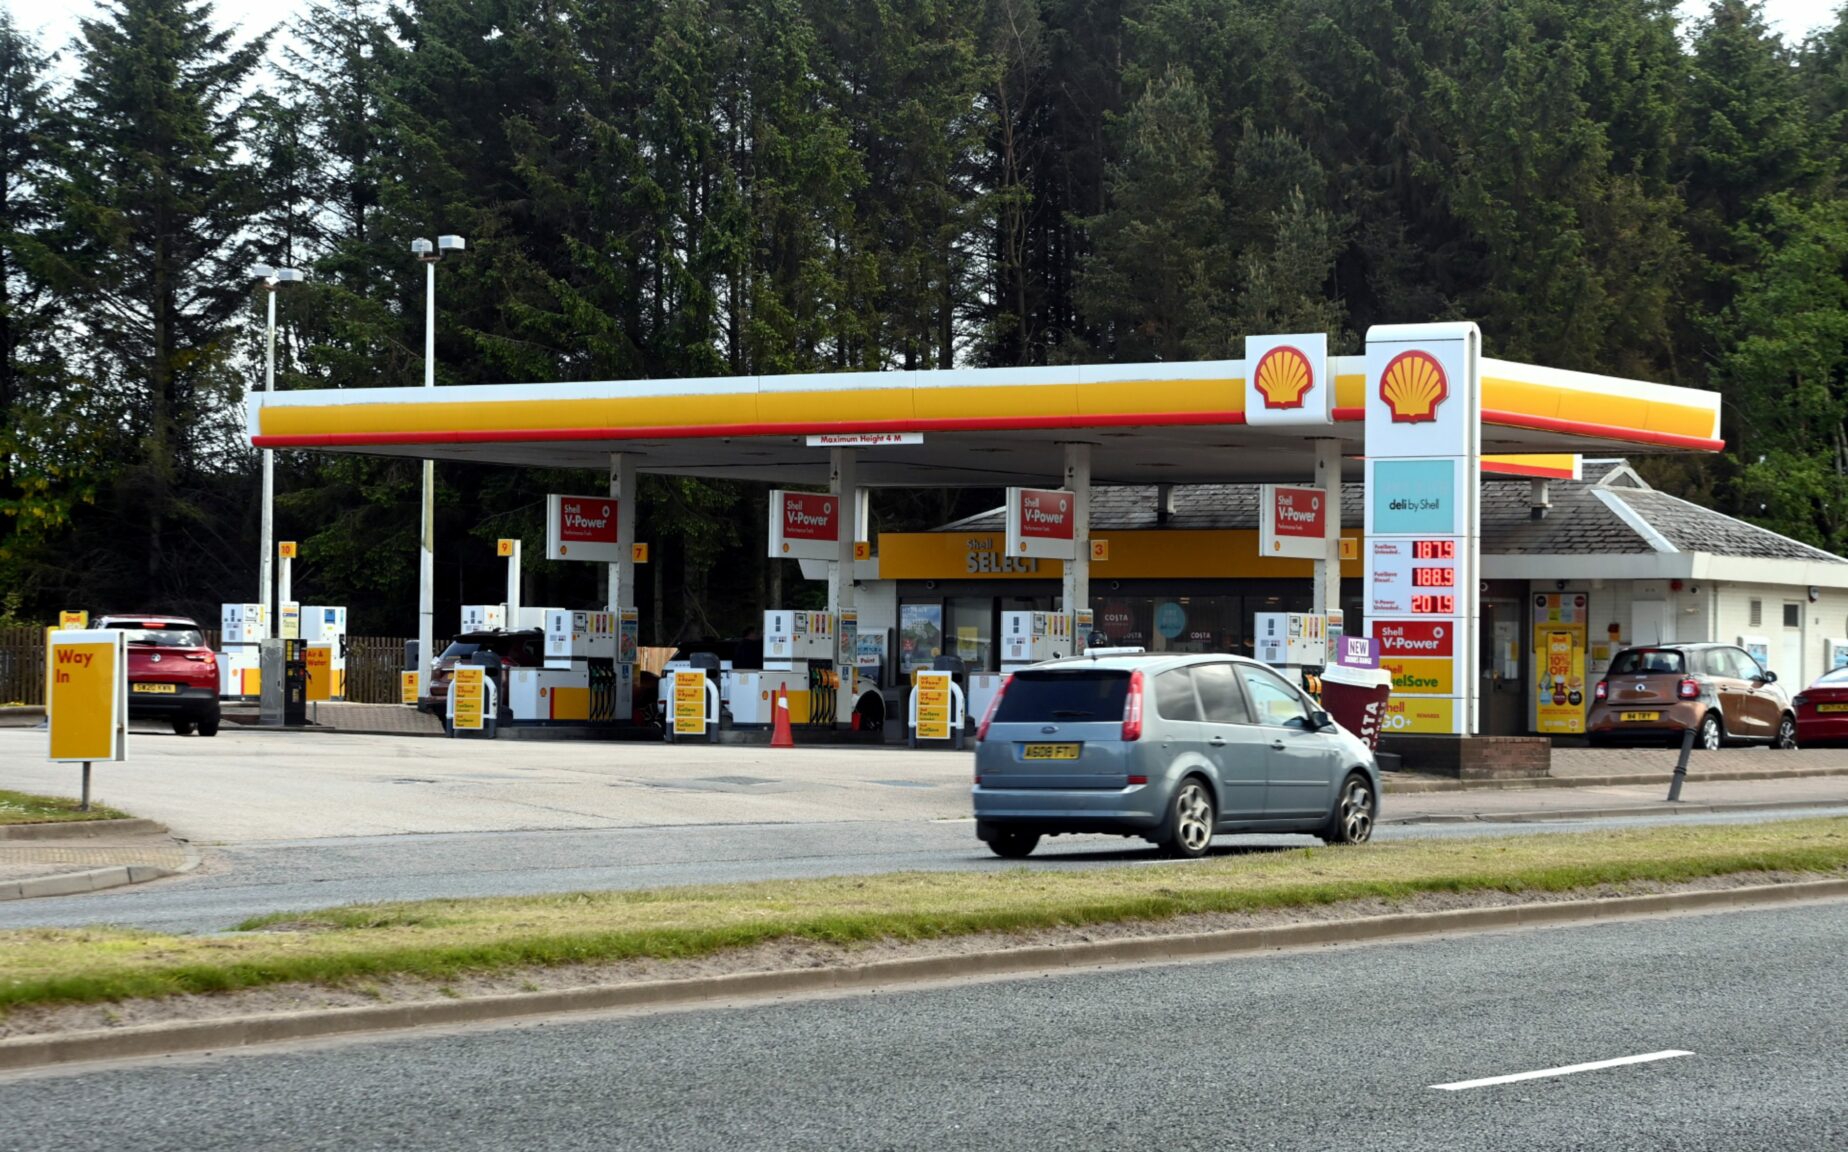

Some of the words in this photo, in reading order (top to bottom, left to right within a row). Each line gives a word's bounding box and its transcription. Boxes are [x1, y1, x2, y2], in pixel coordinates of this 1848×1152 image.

[821, 435, 858, 444] Maximum
[860, 434, 884, 444] Height
[886, 434, 892, 442] 4
[894, 434, 902, 442] M
[786, 500, 803, 510] Shell
[1024, 498, 1040, 508] Shell
[1278, 495, 1293, 506] Shell
[1389, 498, 1407, 510] deli
[1408, 499, 1419, 512] by
[1420, 498, 1440, 510] Shell
[564, 504, 581, 514] Shell
[1278, 506, 1316, 523] V-Power
[564, 515, 607, 528] V-Power
[787, 511, 828, 526] V-Power
[1024, 509, 1064, 524] V-Power
[967, 537, 993, 550] Shell
[1095, 544, 1104, 555] 3
[1416, 541, 1455, 558] 187.9
[636, 547, 643, 558] 7
[857, 546, 864, 556] 5
[966, 552, 1038, 574] SELECT
[1416, 568, 1454, 586] 188.9
[1411, 595, 1454, 613] 201.9
[1104, 614, 1128, 622] COSTA
[1382, 627, 1403, 636] Shell
[1350, 640, 1367, 655] NEW
[1382, 637, 1439, 649] V-Power
[57, 649, 94, 668] Way
[56, 668, 70, 683] In
[1550, 666, 1569, 675] OFF
[1391, 675, 1439, 687] uelSave
[1385, 702, 1404, 712] hell
